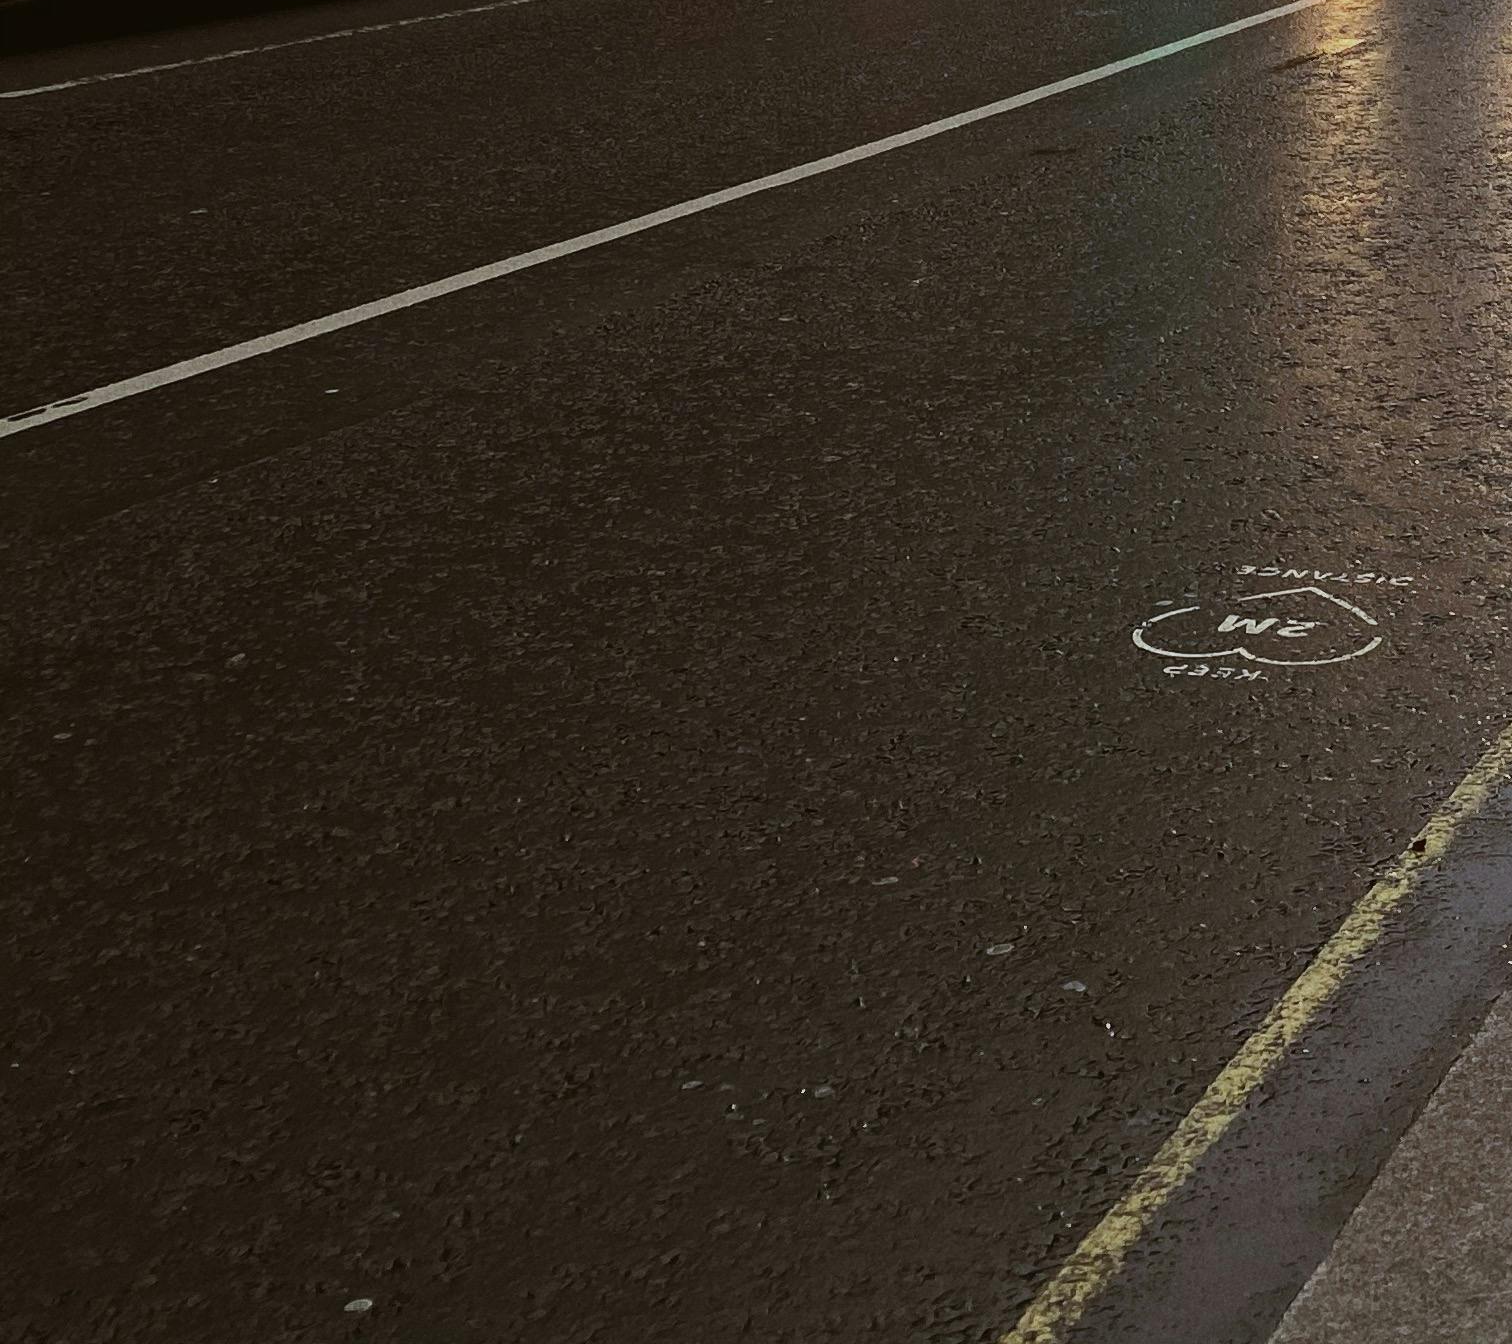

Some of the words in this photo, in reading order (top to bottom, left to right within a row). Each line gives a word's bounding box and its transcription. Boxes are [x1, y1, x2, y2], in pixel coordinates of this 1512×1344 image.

[1236, 565, 1414, 586] DISTANCE
[1217, 614, 1317, 638] 2M
[1163, 664, 1268, 682] KEEP
